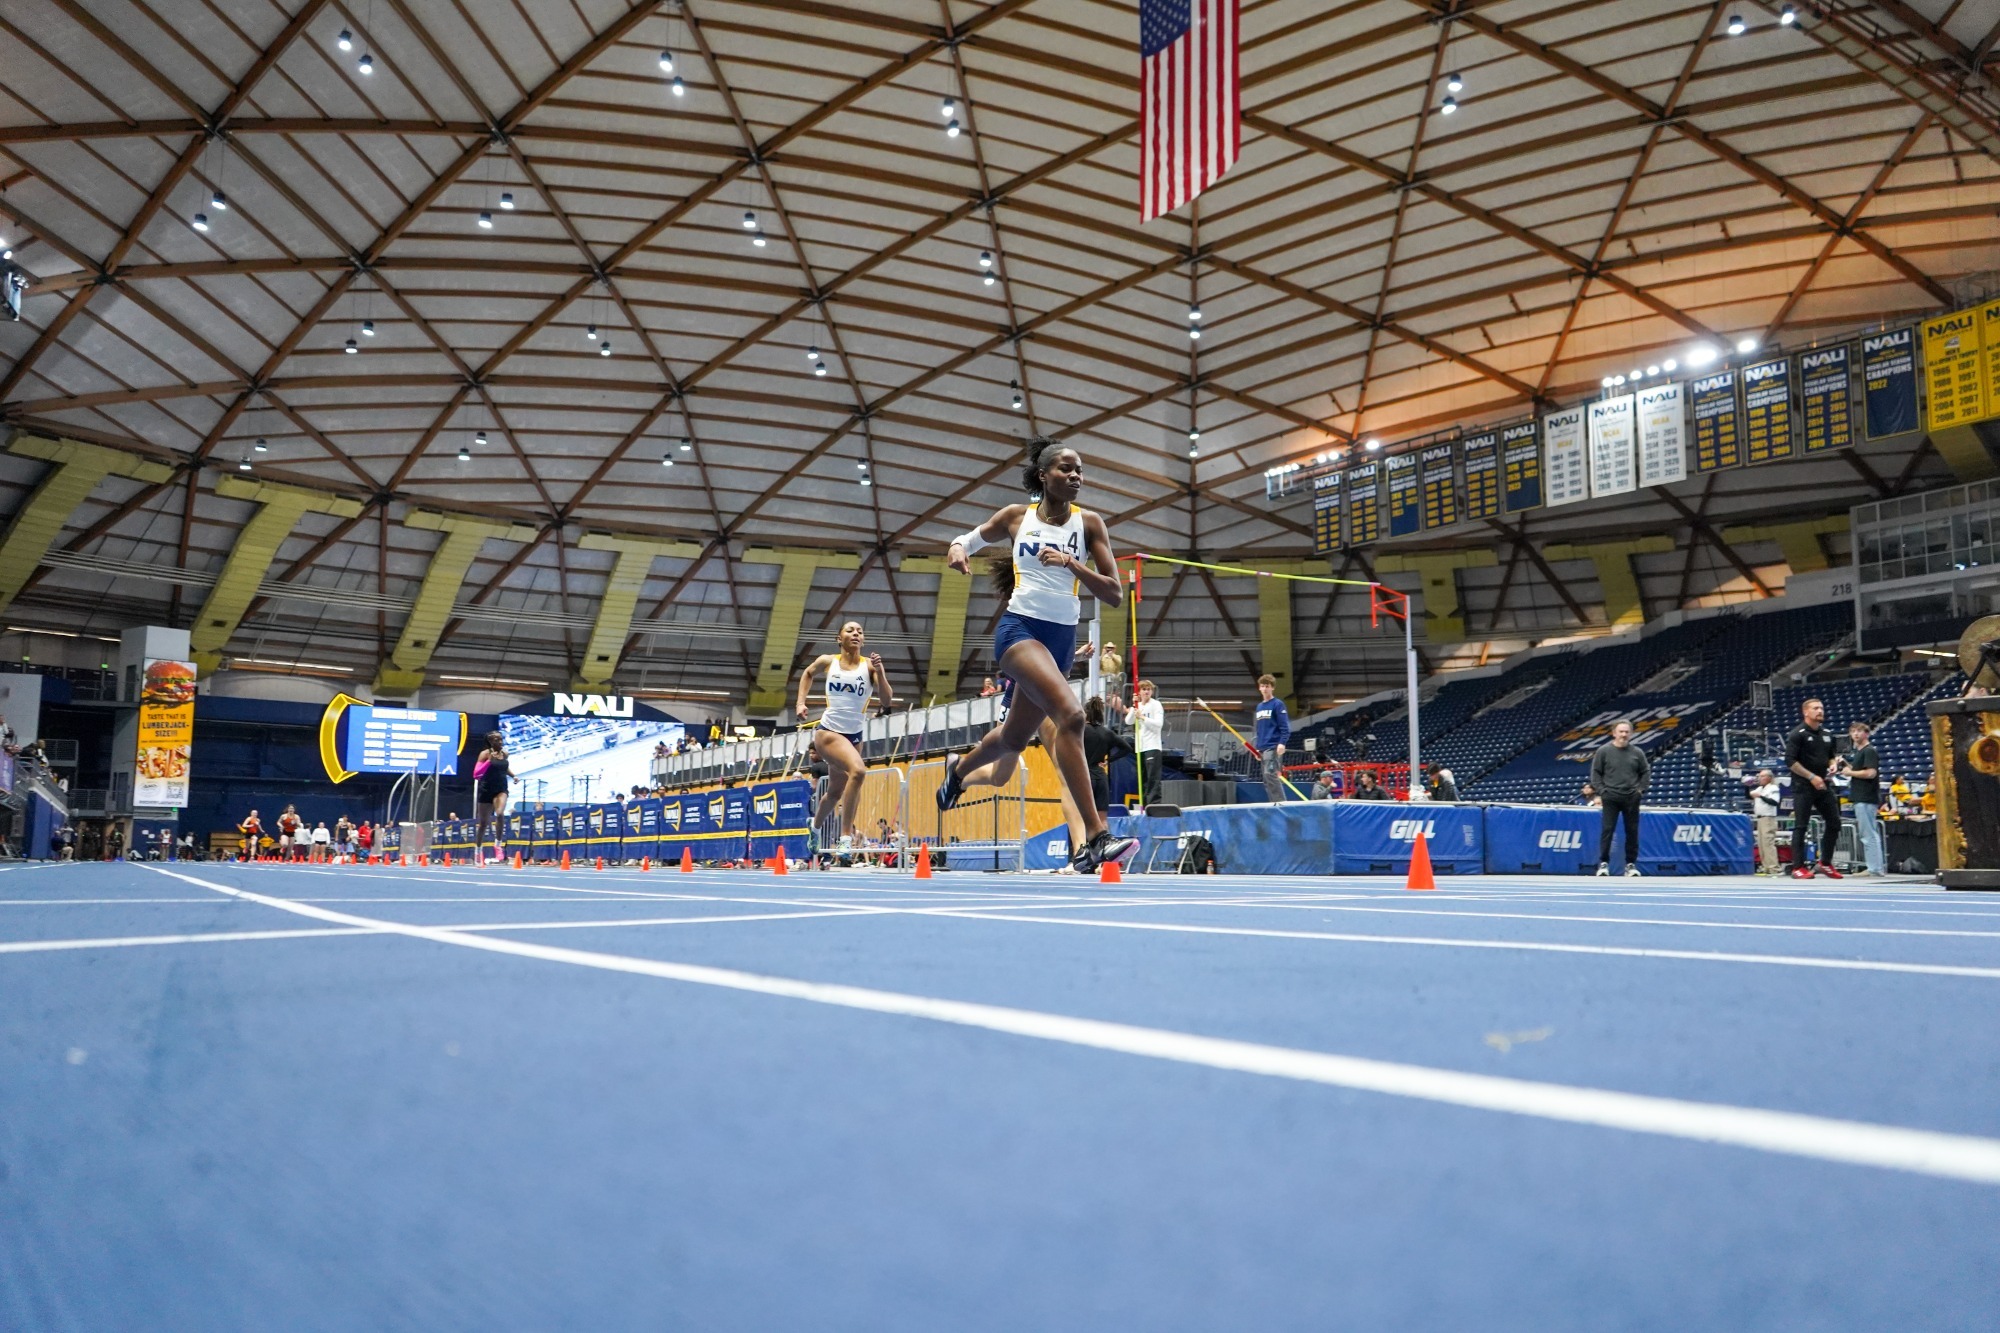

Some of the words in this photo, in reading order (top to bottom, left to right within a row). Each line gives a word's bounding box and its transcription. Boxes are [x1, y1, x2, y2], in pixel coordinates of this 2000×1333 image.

[1928, 316, 1972, 337] NAU
[1864, 331, 1909, 353] NAU
[1803, 349, 1845, 369] NAU
[1746, 362, 1786, 382] NAU
[1866, 363, 1912, 381] CHAMPIONS
[1694, 374, 1732, 393] NAU
[1805, 380, 1847, 396] CHAMPIONS
[1868, 379, 1888, 391] 2022
[1643, 389, 1677, 405] NAU
[1748, 392, 1788, 408] CHAMPIONS
[1595, 403, 1627, 418] NAU
[1696, 404, 1734, 420] CHAMPIONS
[1549, 414, 1579, 429] NAU
[1504, 424, 1535, 441] NAU
[1466, 435, 1495, 450] NAU
[1423, 446, 1451, 462] NAU
[1389, 455, 1416, 470] NAU
[1350, 465, 1376, 480] NAU
[1315, 475, 1339, 490] NAU
[1068, 532, 1078, 553] 4
[1832, 584, 1852, 596] 218
[829, 682, 857, 693] NA
[858, 682, 865, 696] 6
[553, 692, 634, 718] NAU
[999, 706, 1008, 723] 3
[757, 800, 774, 814] NAU
[1390, 820, 1436, 839] GILL
[1674, 825, 1712, 843] GILL
[1178, 830, 1212, 849] GL
[1539, 830, 1582, 849] GILL
